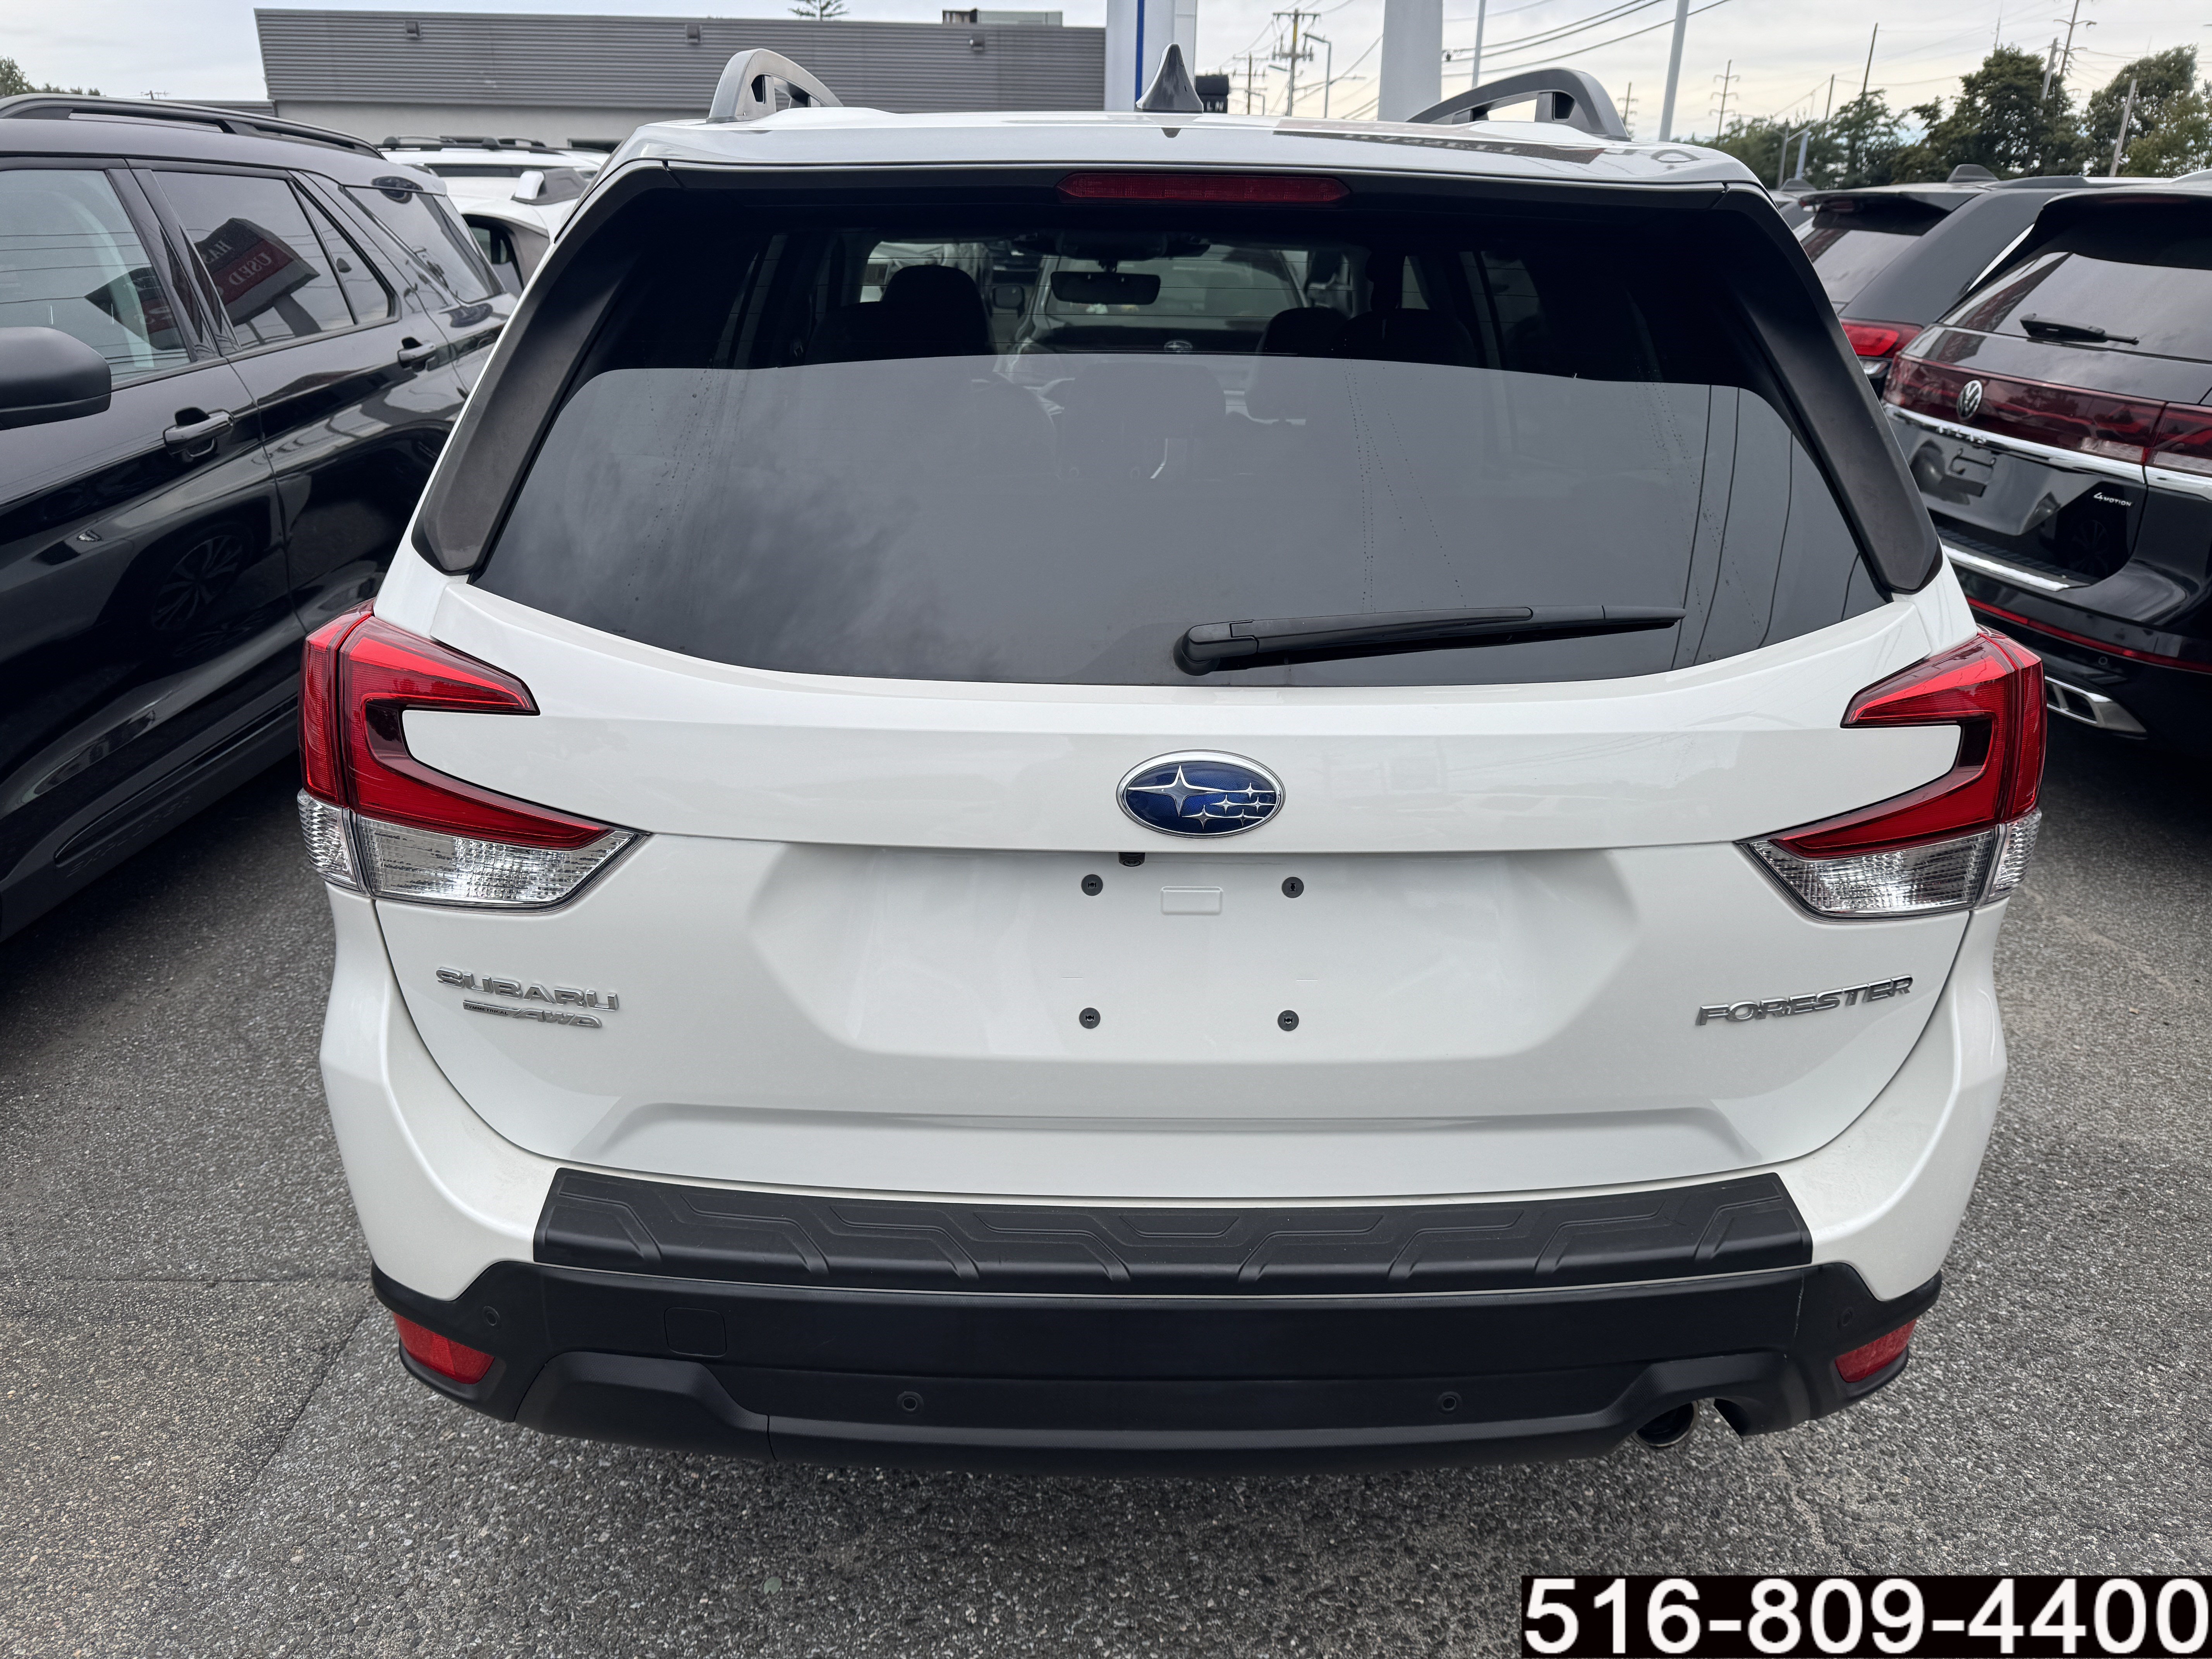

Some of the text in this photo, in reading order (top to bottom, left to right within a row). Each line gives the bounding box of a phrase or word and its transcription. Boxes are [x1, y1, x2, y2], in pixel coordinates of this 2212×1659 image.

[436, 967, 620, 1011] SUBARU
[1695, 974, 1913, 1026] FORESTER
[512, 1008, 603, 1029] AWD
